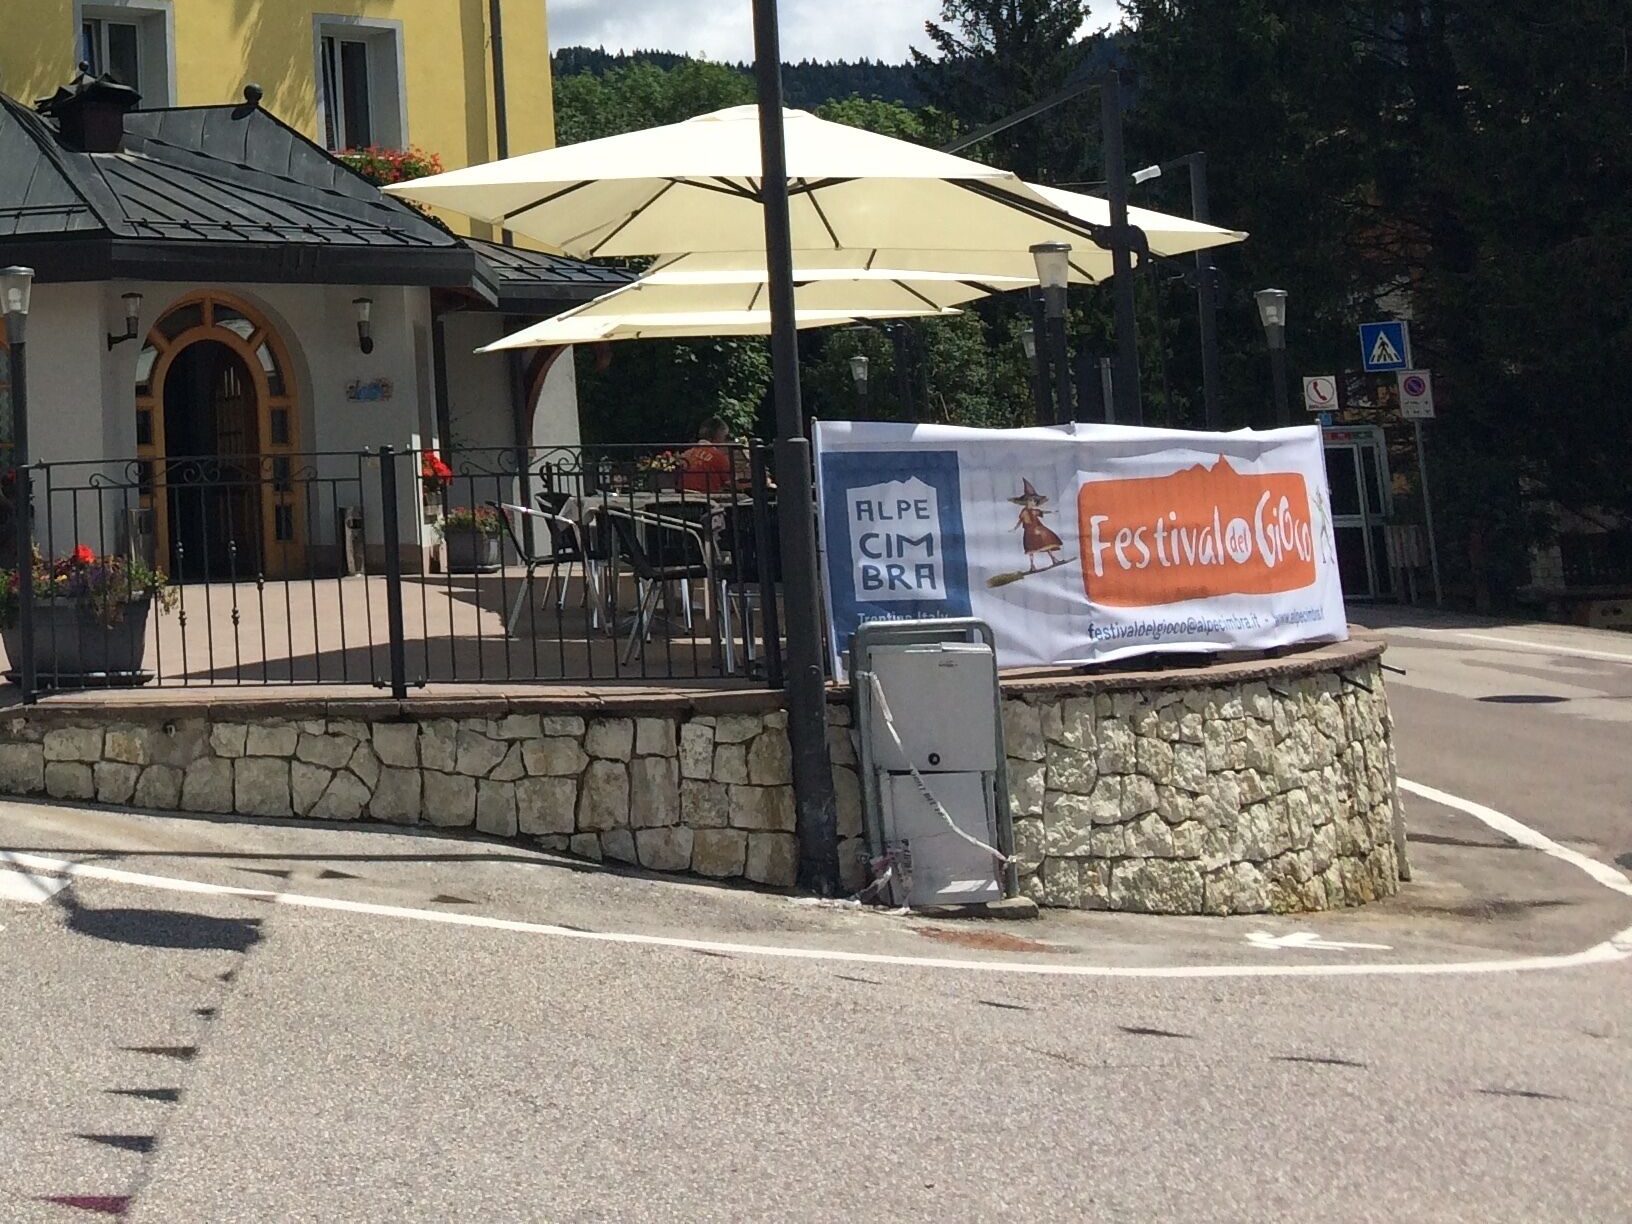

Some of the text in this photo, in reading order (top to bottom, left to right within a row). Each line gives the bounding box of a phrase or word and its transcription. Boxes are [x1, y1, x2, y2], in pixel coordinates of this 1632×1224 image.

[855, 498, 930, 522] ALPE
[858, 532, 934, 559] CIM
[1089, 505, 1224, 577] Festival
[1230, 526, 1249, 553] del
[862, 563, 937, 591] BRA
[1088, 614, 1260, 641] festivaldelgioco@alpecimbra.it
